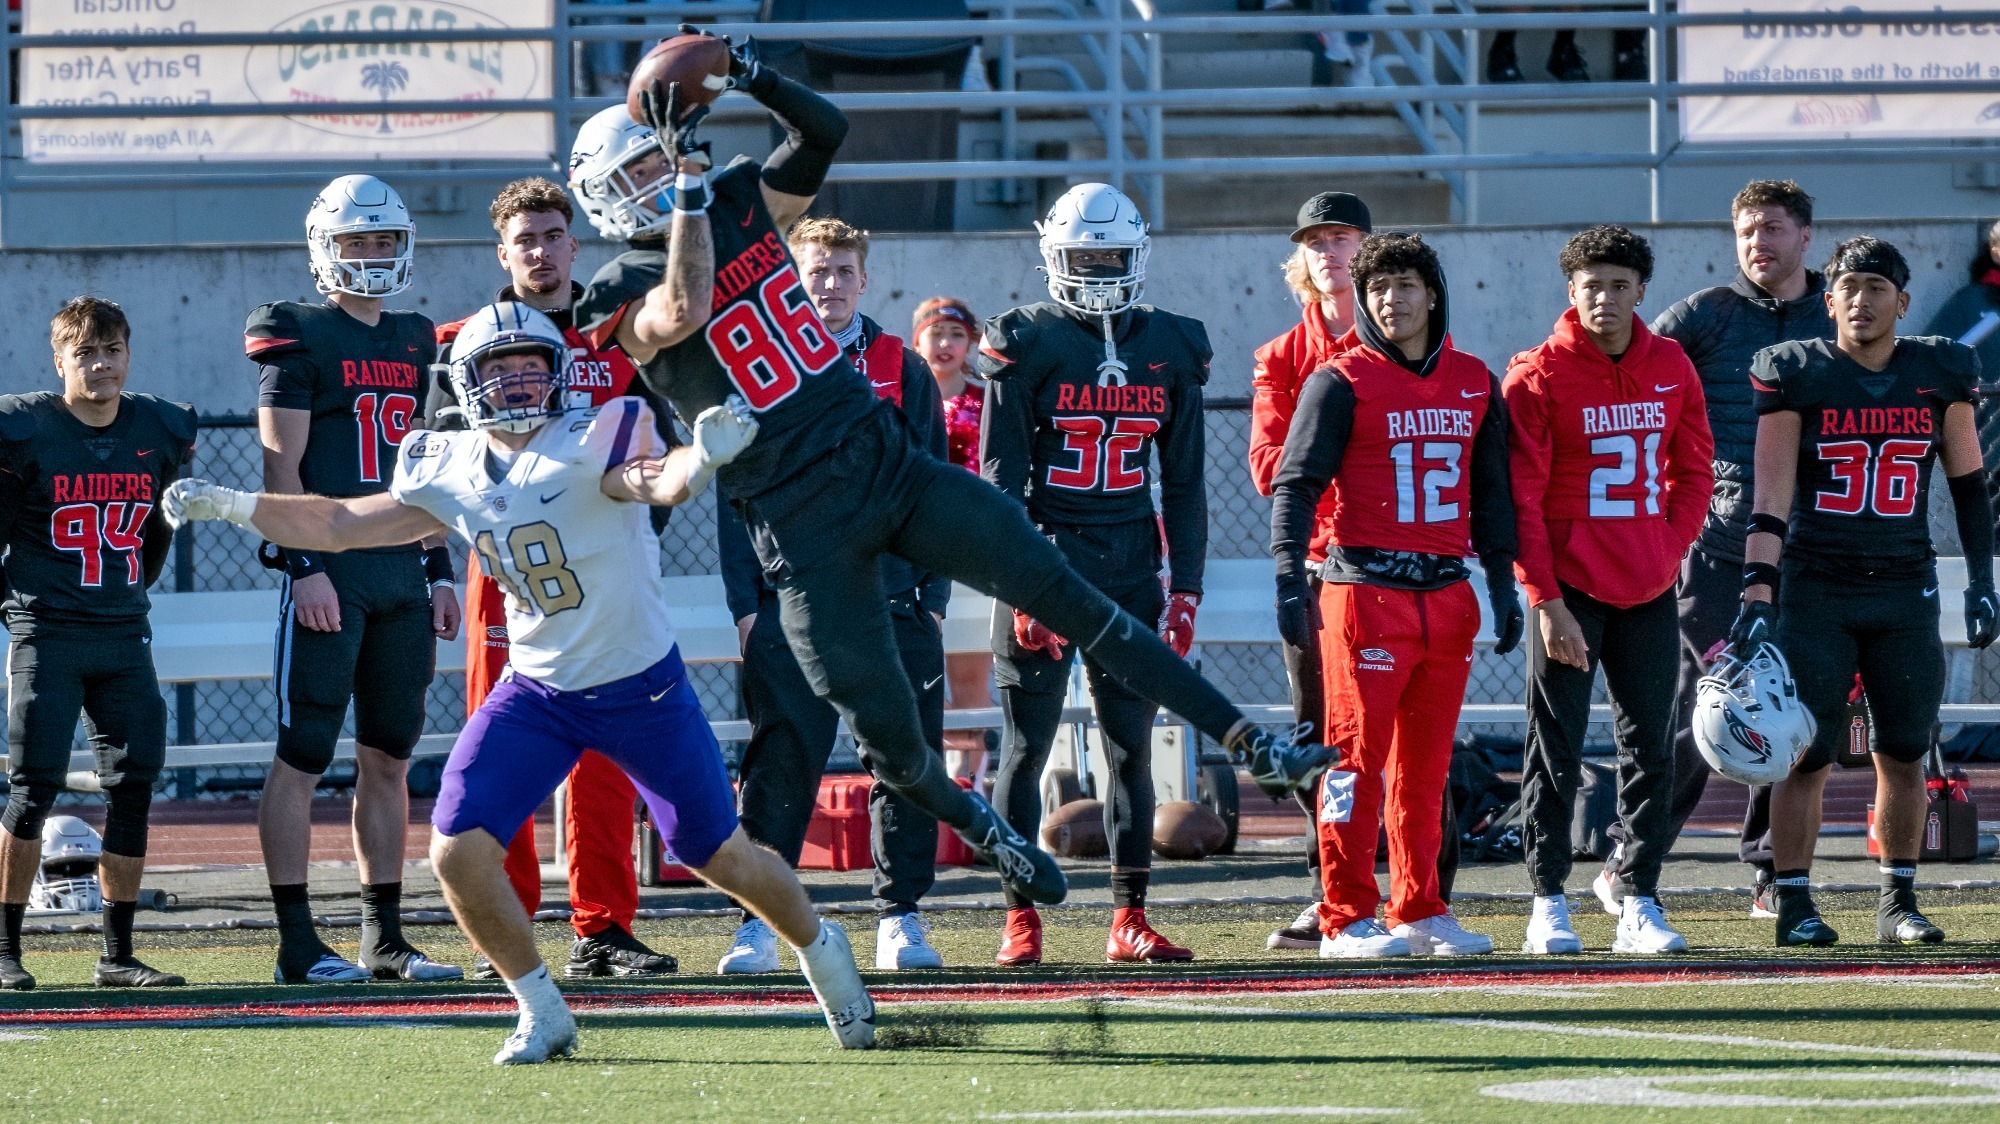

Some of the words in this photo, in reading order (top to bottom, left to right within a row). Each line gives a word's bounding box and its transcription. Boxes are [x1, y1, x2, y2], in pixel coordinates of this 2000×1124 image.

[712, 230, 787, 311] AIDERS
[706, 266, 843, 413] 86
[1056, 384, 1165, 413] RAIDERS
[1387, 409, 1473, 438] RAIDERS
[1582, 402, 1666, 434] RAIDERS
[1821, 408, 1933, 434] RAIDERS
[54, 473, 153, 502] RAIDERS
[1046, 416, 1161, 491] 32
[1389, 441, 1463, 524] 12
[1589, 431, 1662, 518] 21
[1815, 439, 1932, 517] 36
[51, 502, 153, 586] 94
[475, 520, 585, 617] 18
[1359, 663, 1394, 671] FOOTBALL
